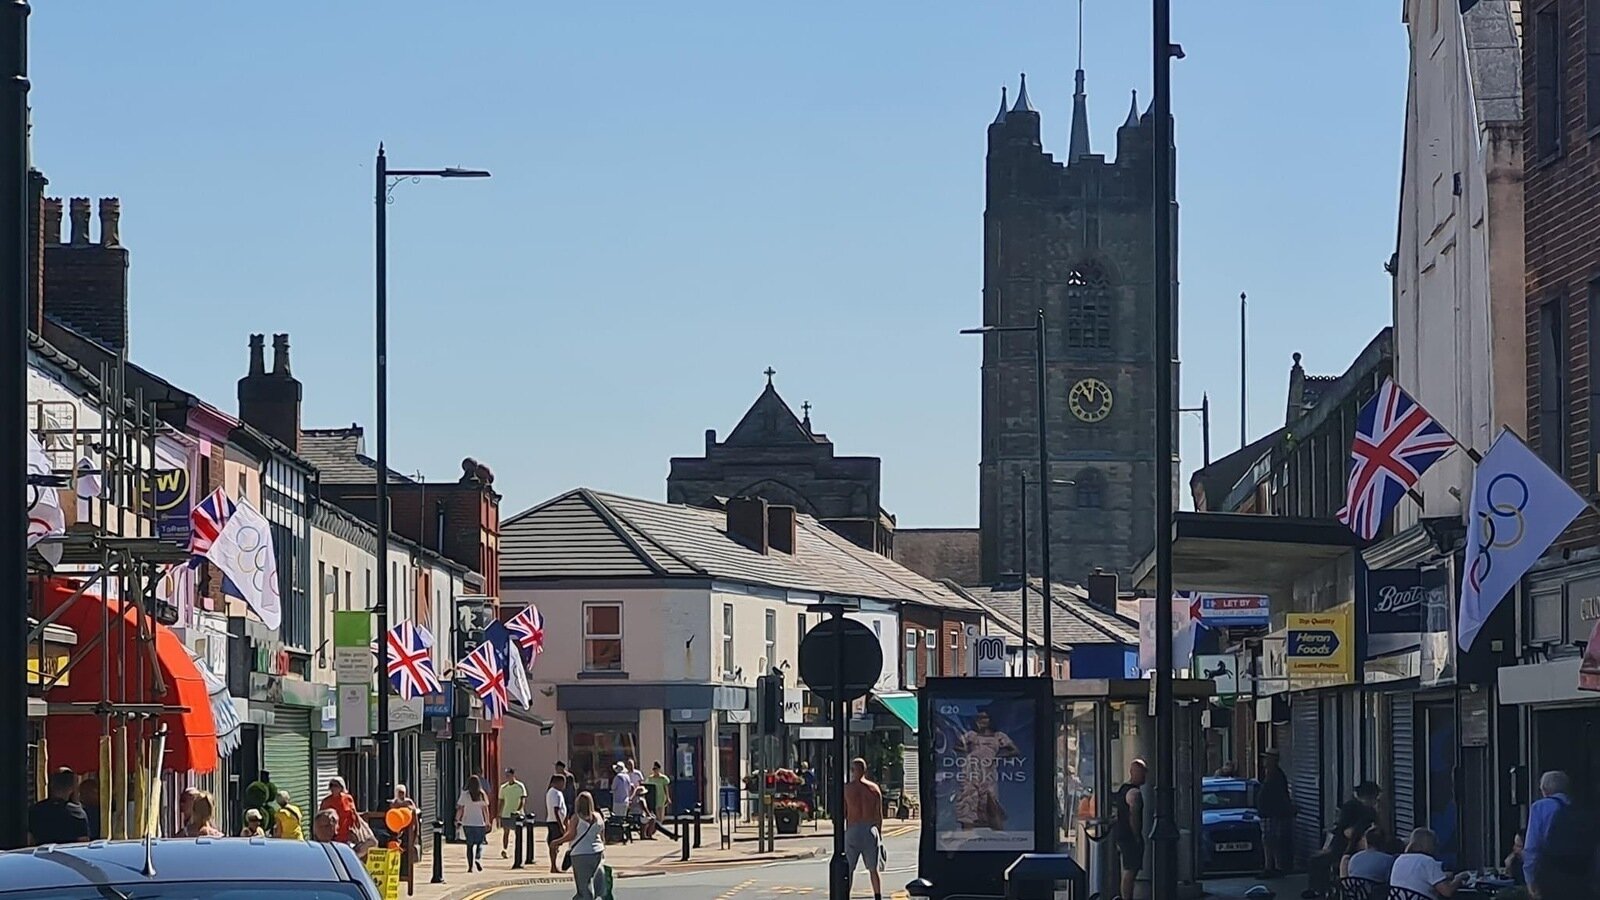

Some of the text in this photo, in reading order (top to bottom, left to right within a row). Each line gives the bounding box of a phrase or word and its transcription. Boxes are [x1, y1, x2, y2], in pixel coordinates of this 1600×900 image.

[1223, 600, 1237, 608] LET
[1296, 633, 1331, 642] Heron
[1296, 644, 1331, 654] Foods
[943, 757, 1027, 768] DOROTHY
[943, 771, 1026, 783] PERKINS
